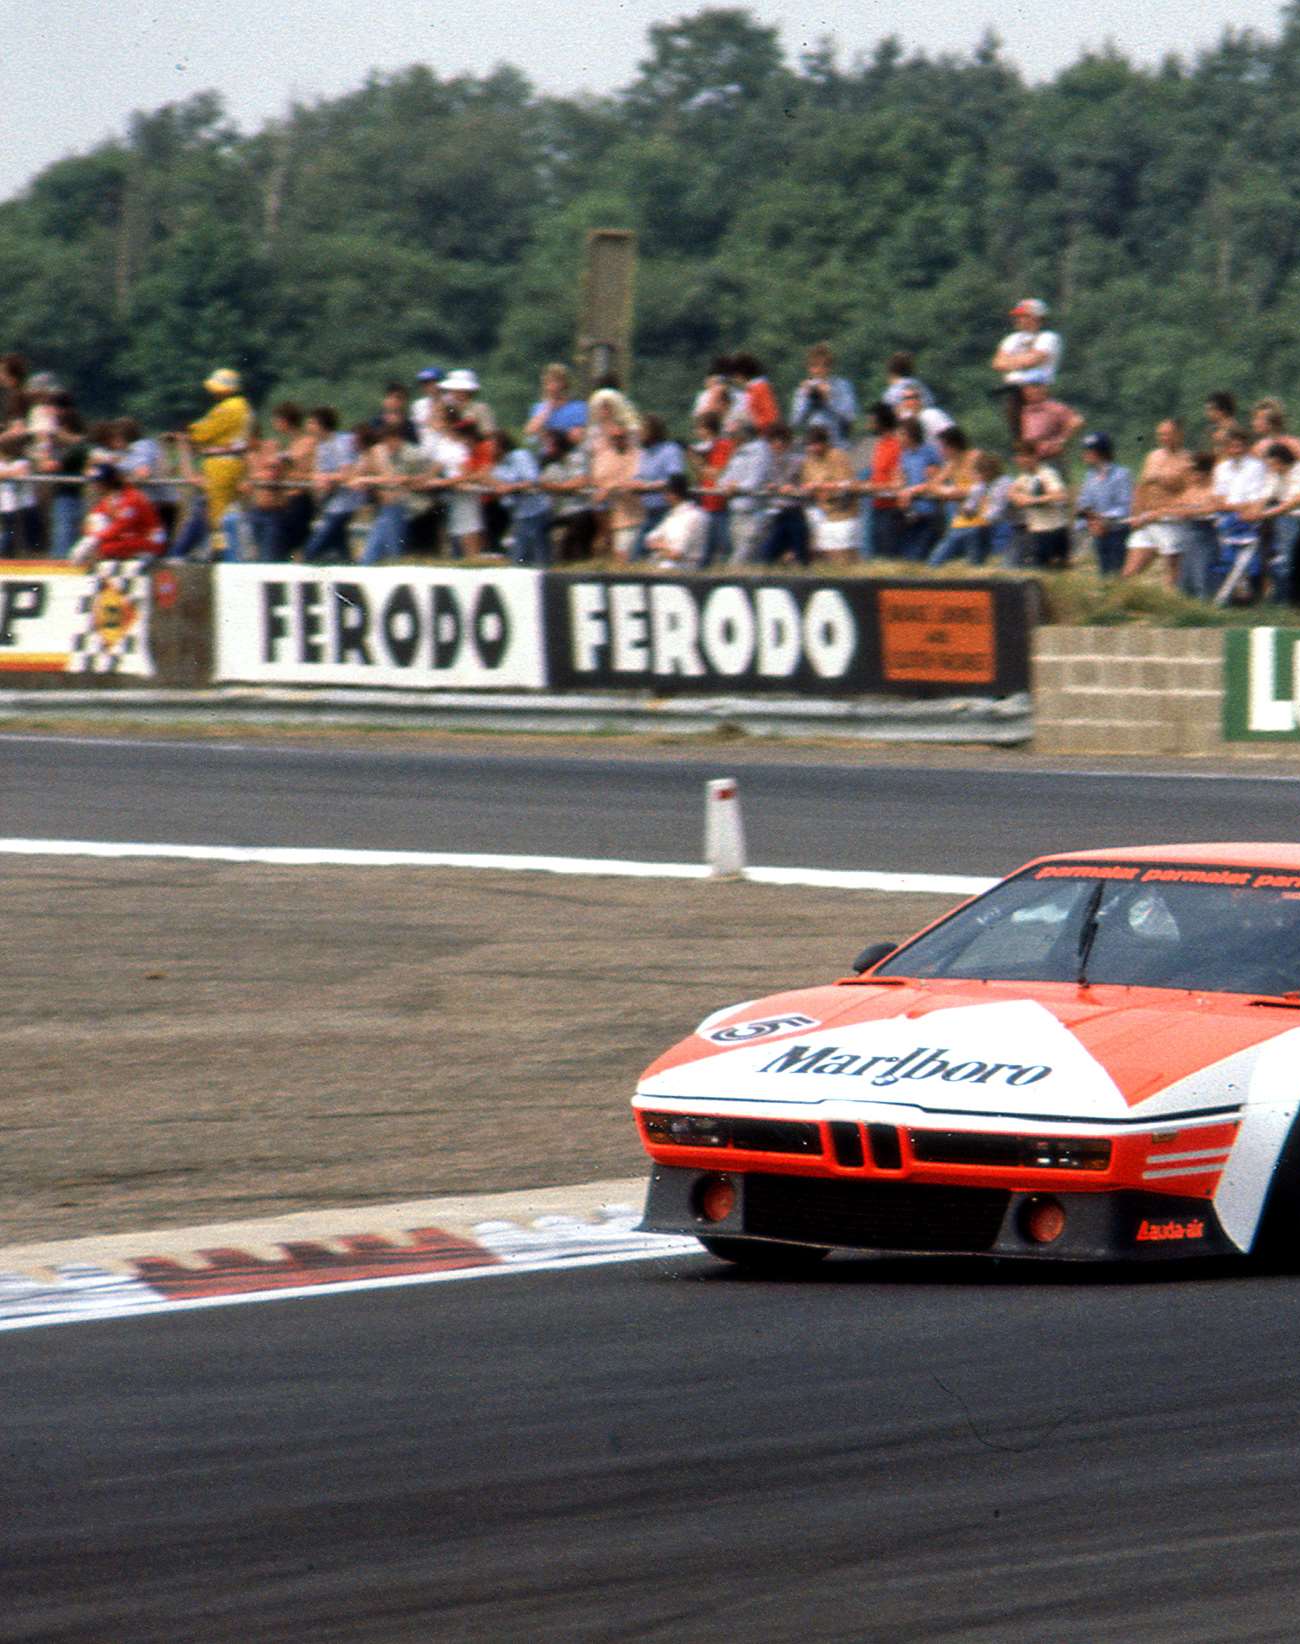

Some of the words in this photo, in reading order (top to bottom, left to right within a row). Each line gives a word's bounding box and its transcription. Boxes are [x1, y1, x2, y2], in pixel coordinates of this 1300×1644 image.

[263, 580, 508, 669] FERODO
[570, 583, 856, 678] FERODO
[758, 1045, 1052, 1087] Marlboro
